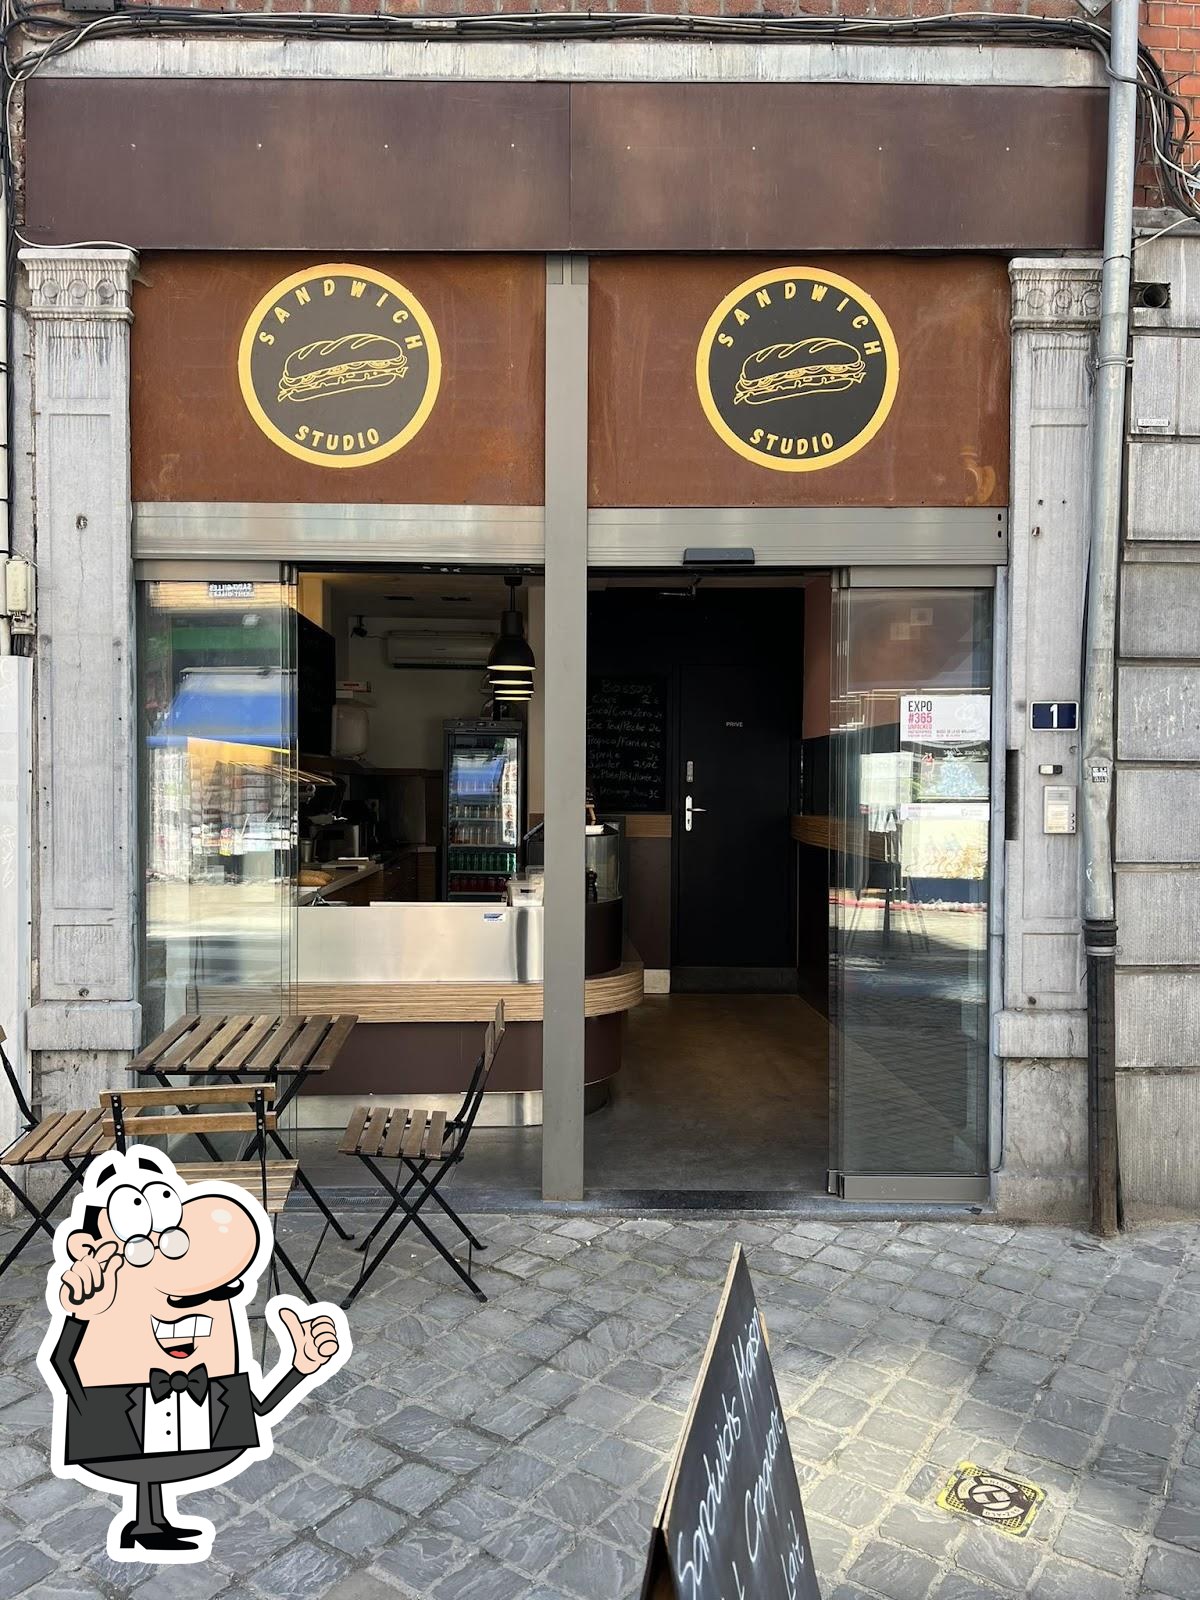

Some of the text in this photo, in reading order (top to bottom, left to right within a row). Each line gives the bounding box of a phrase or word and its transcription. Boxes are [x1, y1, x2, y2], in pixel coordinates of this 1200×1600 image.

[259, 279, 423, 350] SANDWICH
[717, 282, 882, 355] SANDWICH
[295, 425, 380, 451] STUDIO
[750, 428, 834, 455] STUDIO
[908, 700, 933, 713] EXPO
[908, 713, 933, 724] #365
[1049, 703, 1059, 729] 1
